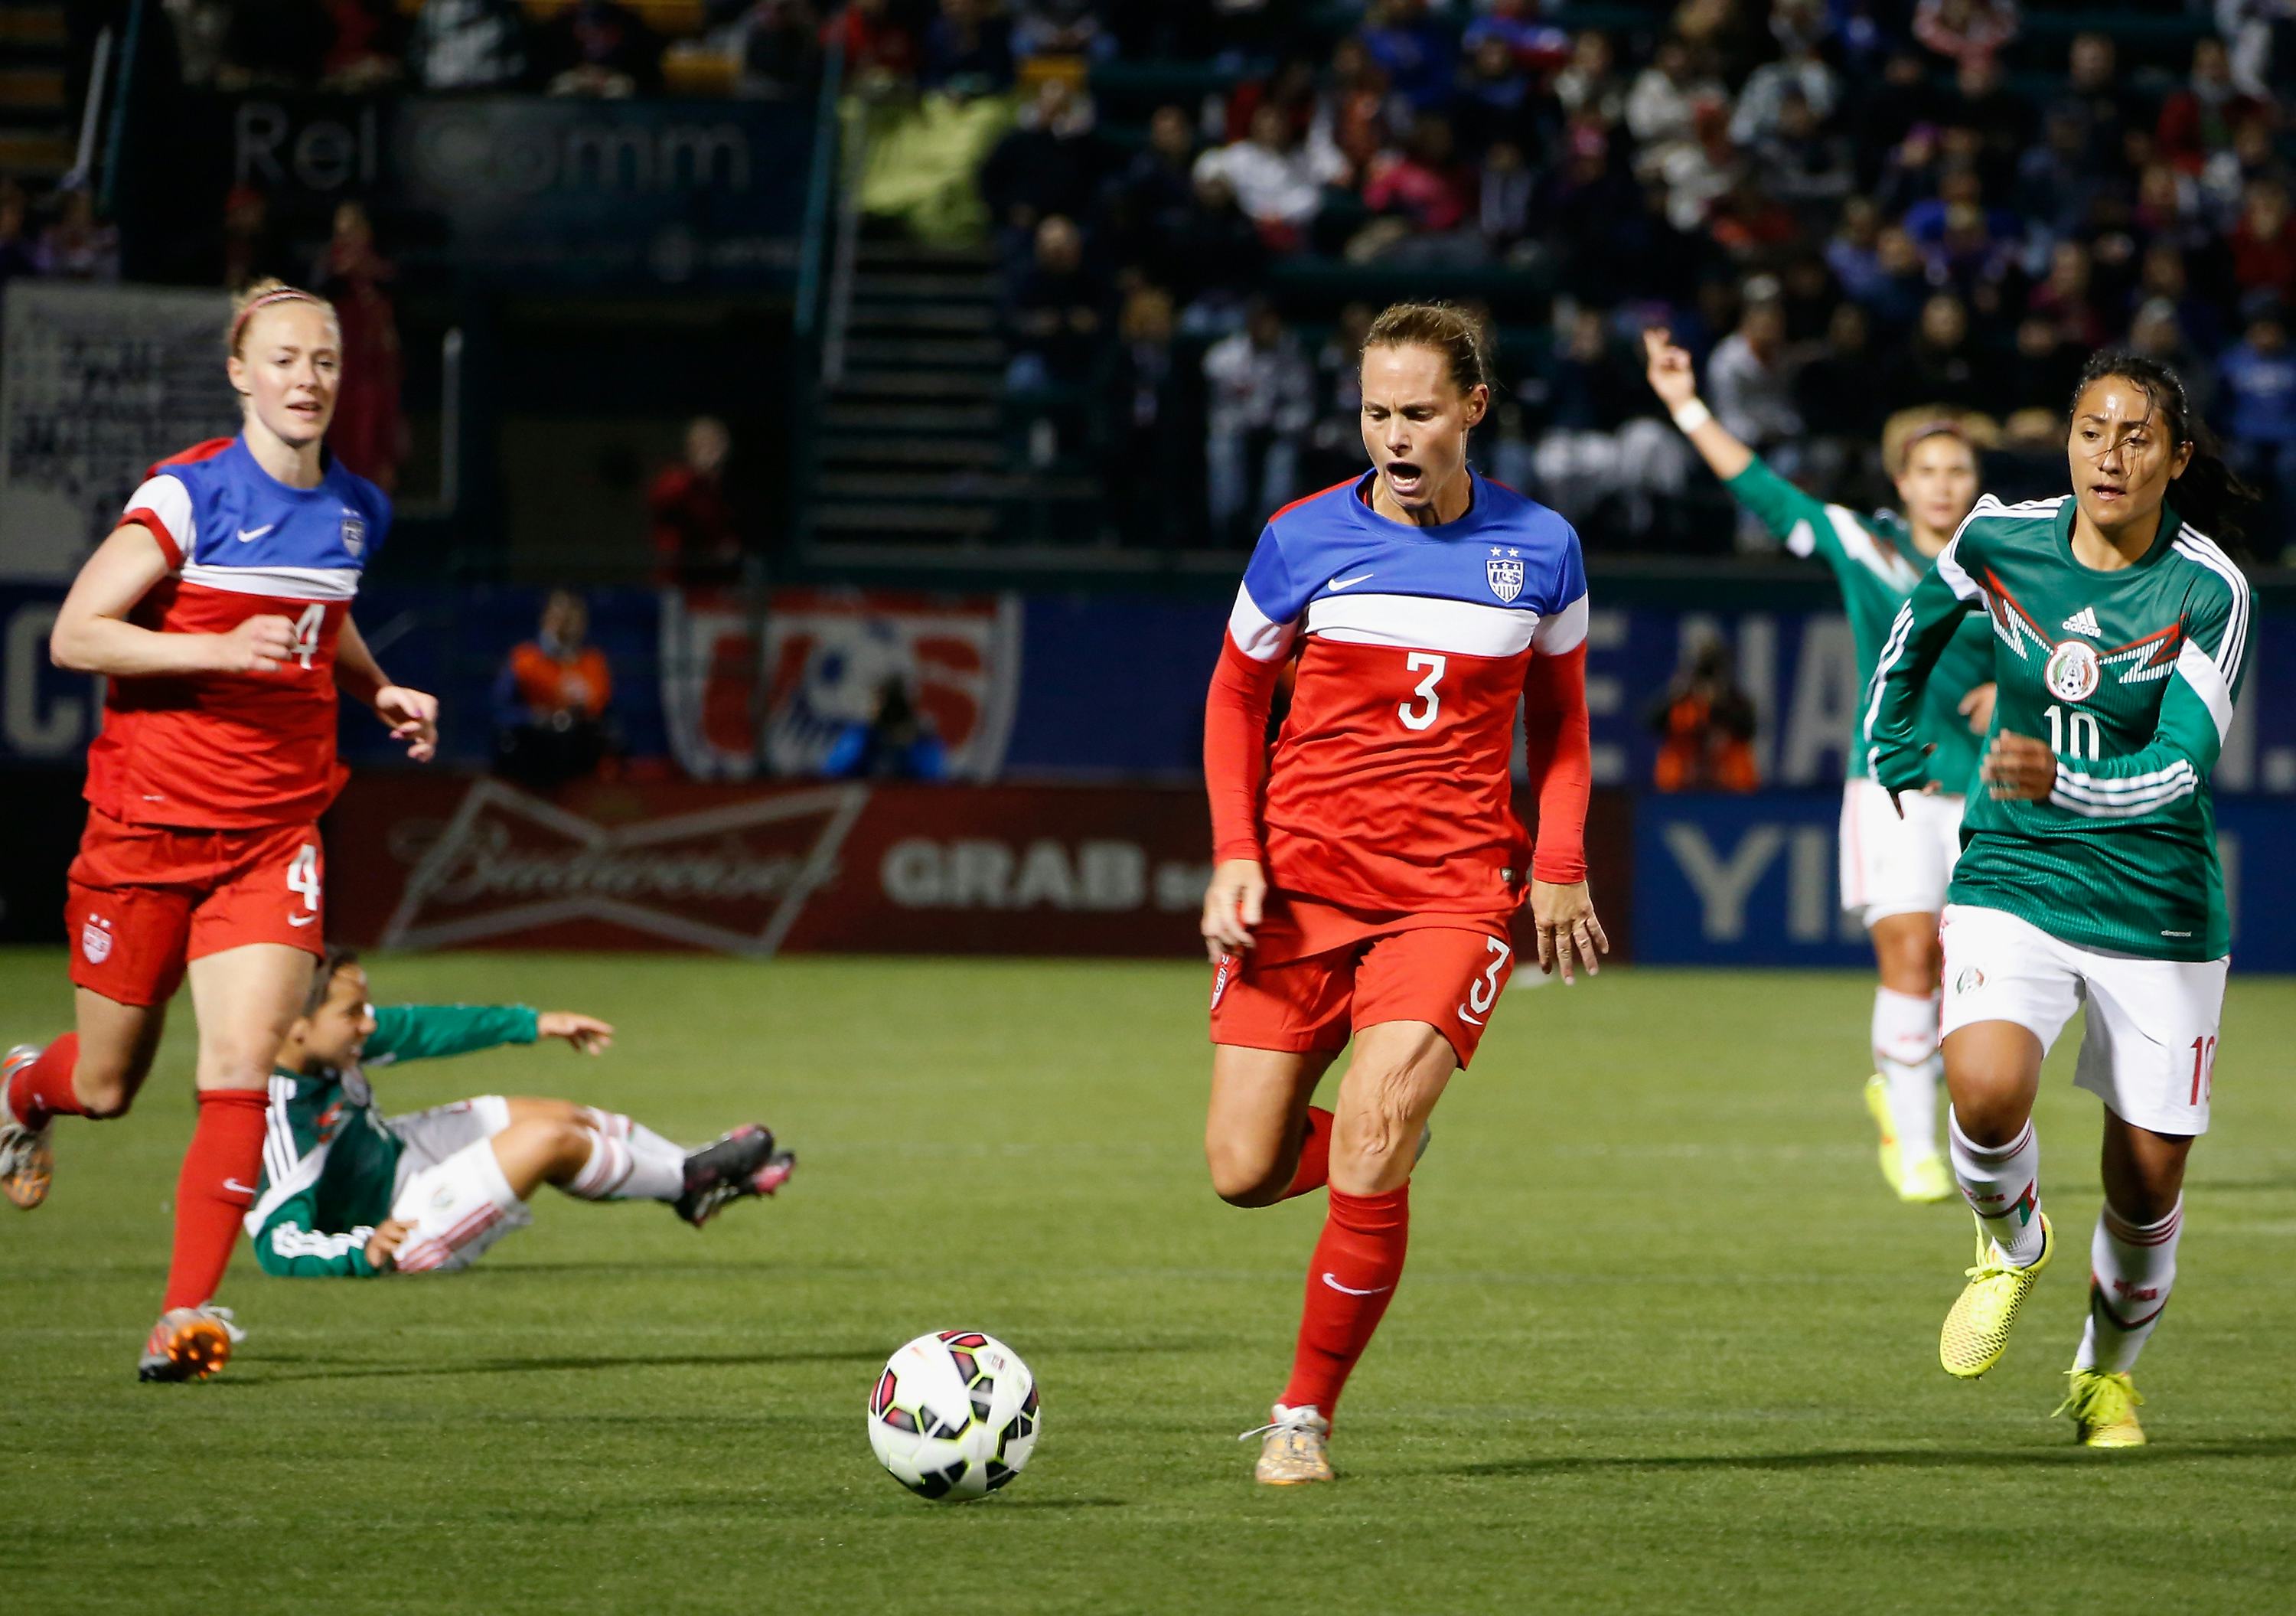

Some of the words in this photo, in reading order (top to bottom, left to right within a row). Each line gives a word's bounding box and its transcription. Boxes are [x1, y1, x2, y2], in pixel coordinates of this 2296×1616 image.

[292, 602, 326, 670] 4
[2062, 621, 2102, 638] adidas
[1398, 652, 1446, 730] 3
[2043, 704, 2100, 762] 10
[287, 844, 321, 911] 4
[880, 837, 1145, 909] GRAB
[1469, 935, 1510, 1010] 3
